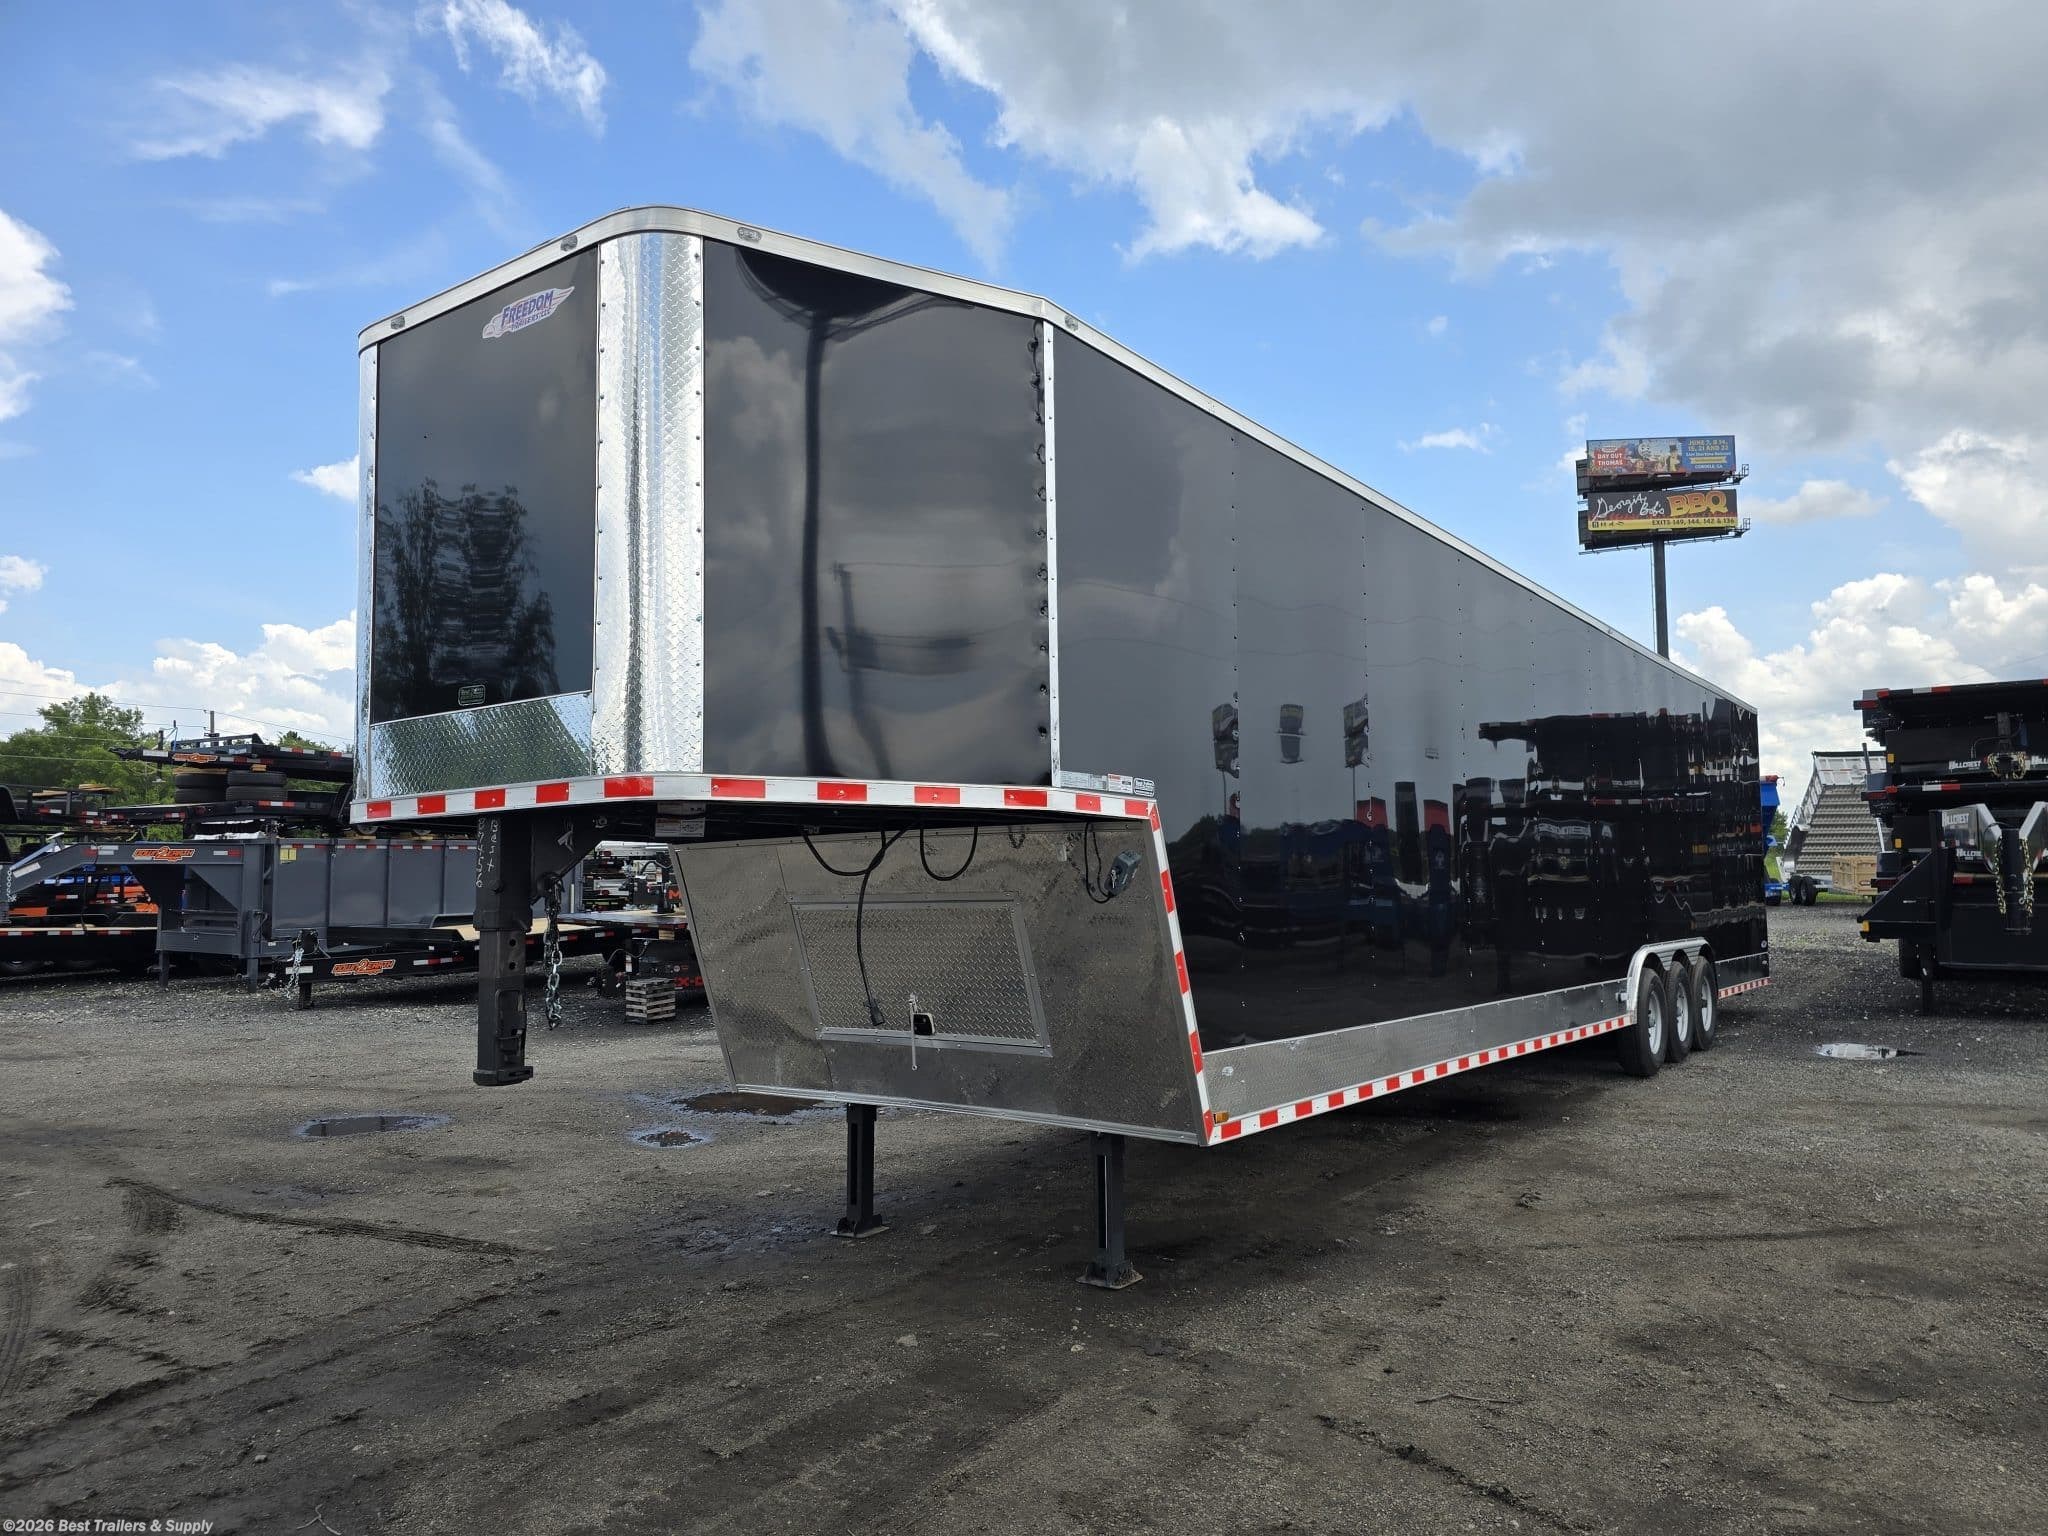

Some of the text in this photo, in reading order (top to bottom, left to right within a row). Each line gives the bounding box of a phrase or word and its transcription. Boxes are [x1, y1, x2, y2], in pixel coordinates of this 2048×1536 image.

[501, 290, 554, 329] FREEDOM
[1667, 490, 1729, 517] BBQ
[1949, 760, 1982, 770] HILLCREST
[1942, 811, 1970, 827] HILLCREST
